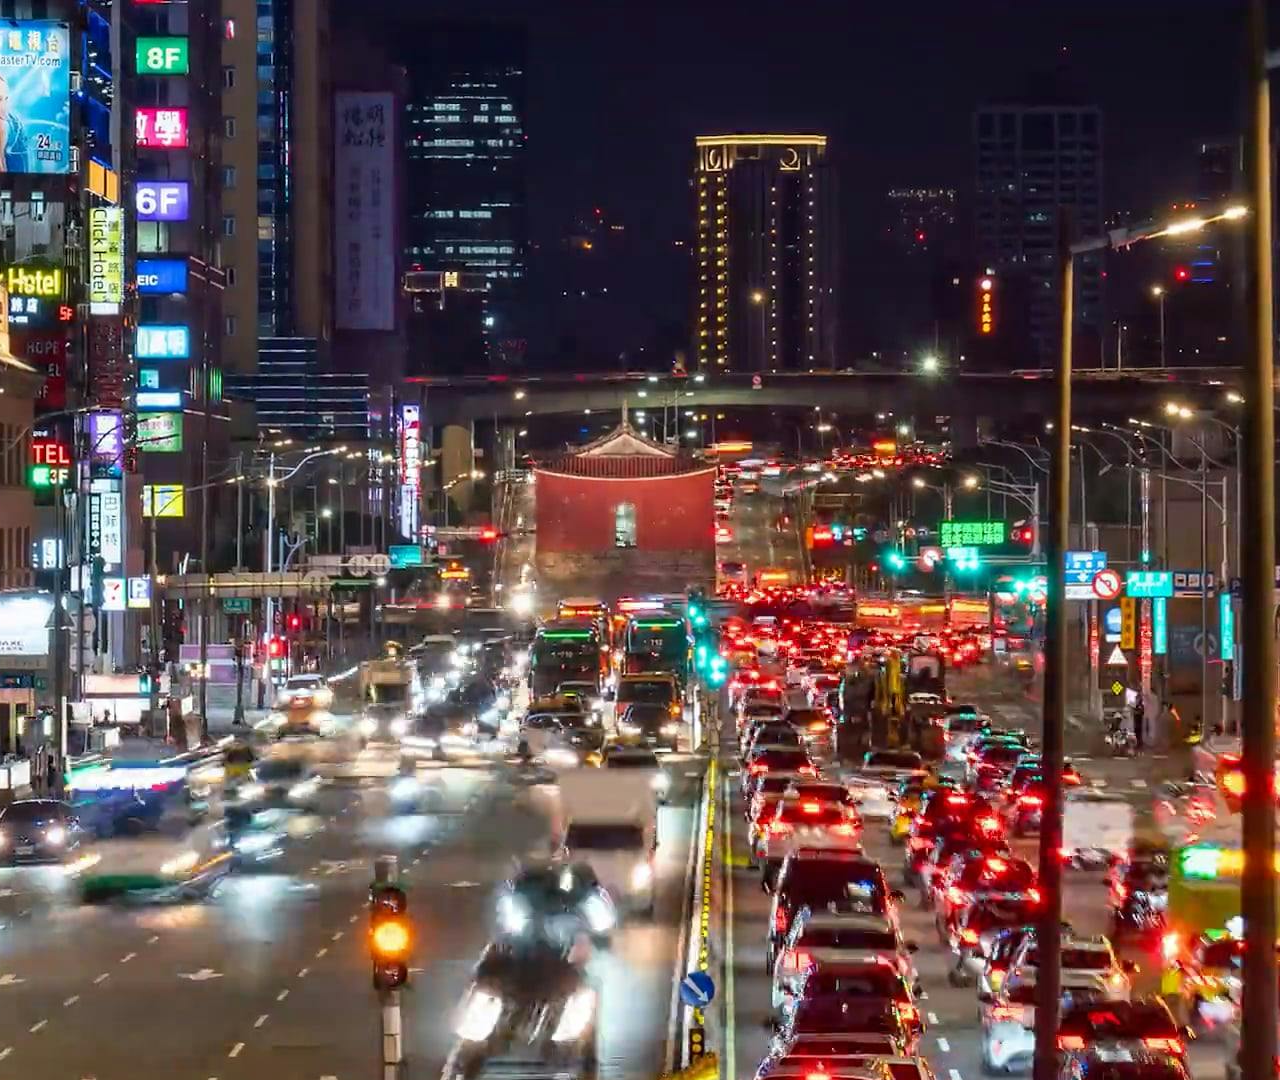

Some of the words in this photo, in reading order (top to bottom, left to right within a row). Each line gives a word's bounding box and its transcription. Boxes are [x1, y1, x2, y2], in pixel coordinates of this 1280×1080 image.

[147, 47, 181, 69] 8F
[136, 187, 179, 214] 6F
[93, 209, 108, 245] Click
[7, 268, 61, 295] Hotel
[93, 251, 108, 294] Hotel
[32, 443, 70, 464] TEL
